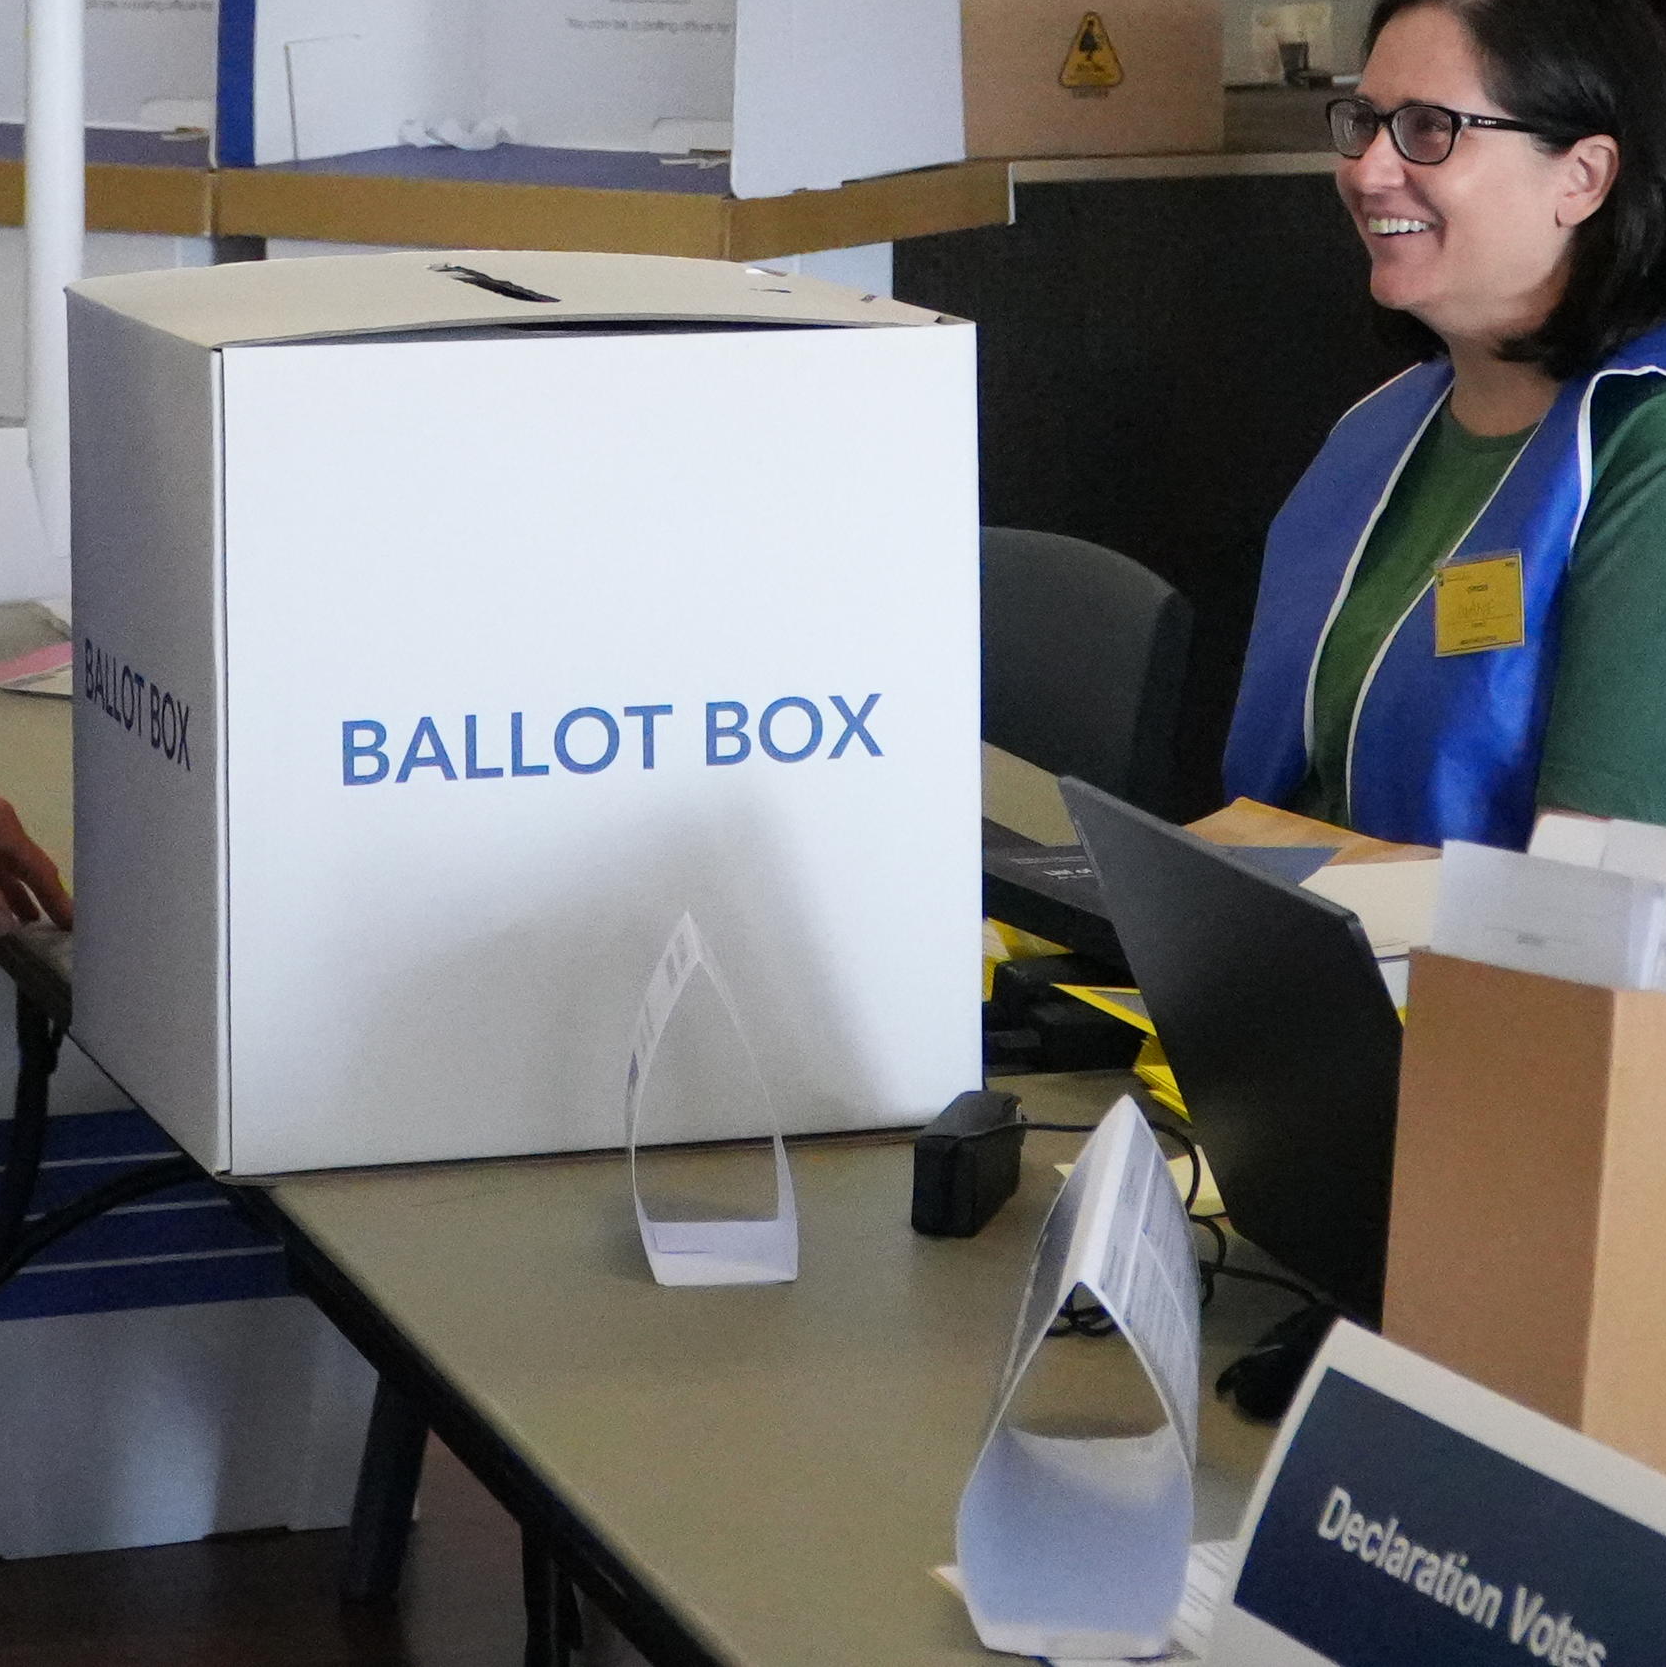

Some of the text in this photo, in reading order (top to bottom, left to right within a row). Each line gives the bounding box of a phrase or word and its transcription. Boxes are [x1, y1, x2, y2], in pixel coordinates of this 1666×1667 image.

[85, 637, 191, 772] BALLOT BOX
[341, 692, 885, 787] BALLOT BOX
[1316, 1486, 1504, 1632] Declaration
[1508, 1583, 1610, 1667] Votes
